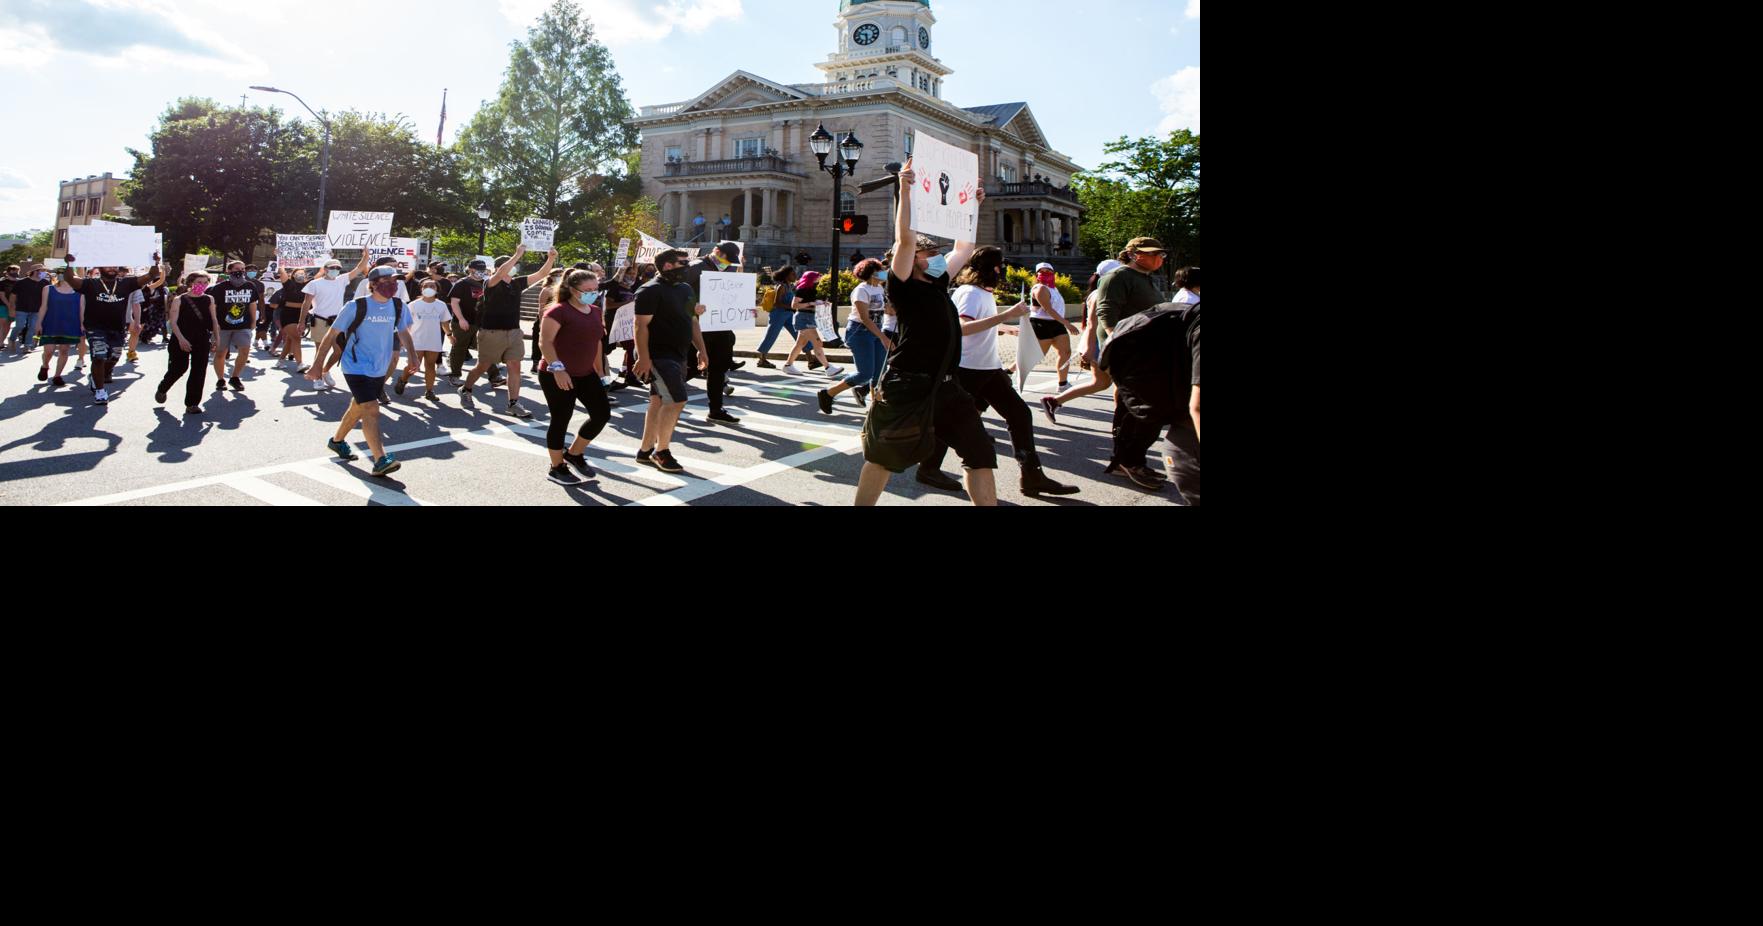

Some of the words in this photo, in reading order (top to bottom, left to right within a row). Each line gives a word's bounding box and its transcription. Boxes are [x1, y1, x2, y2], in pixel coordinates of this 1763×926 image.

[332, 211, 357, 221] WHITE
[358, 211, 391, 221] SILENCE
[328, 232, 390, 247] VIOLENCE
[225, 288, 252, 296] PUBLIC
[710, 307, 754, 326] FLOYD
